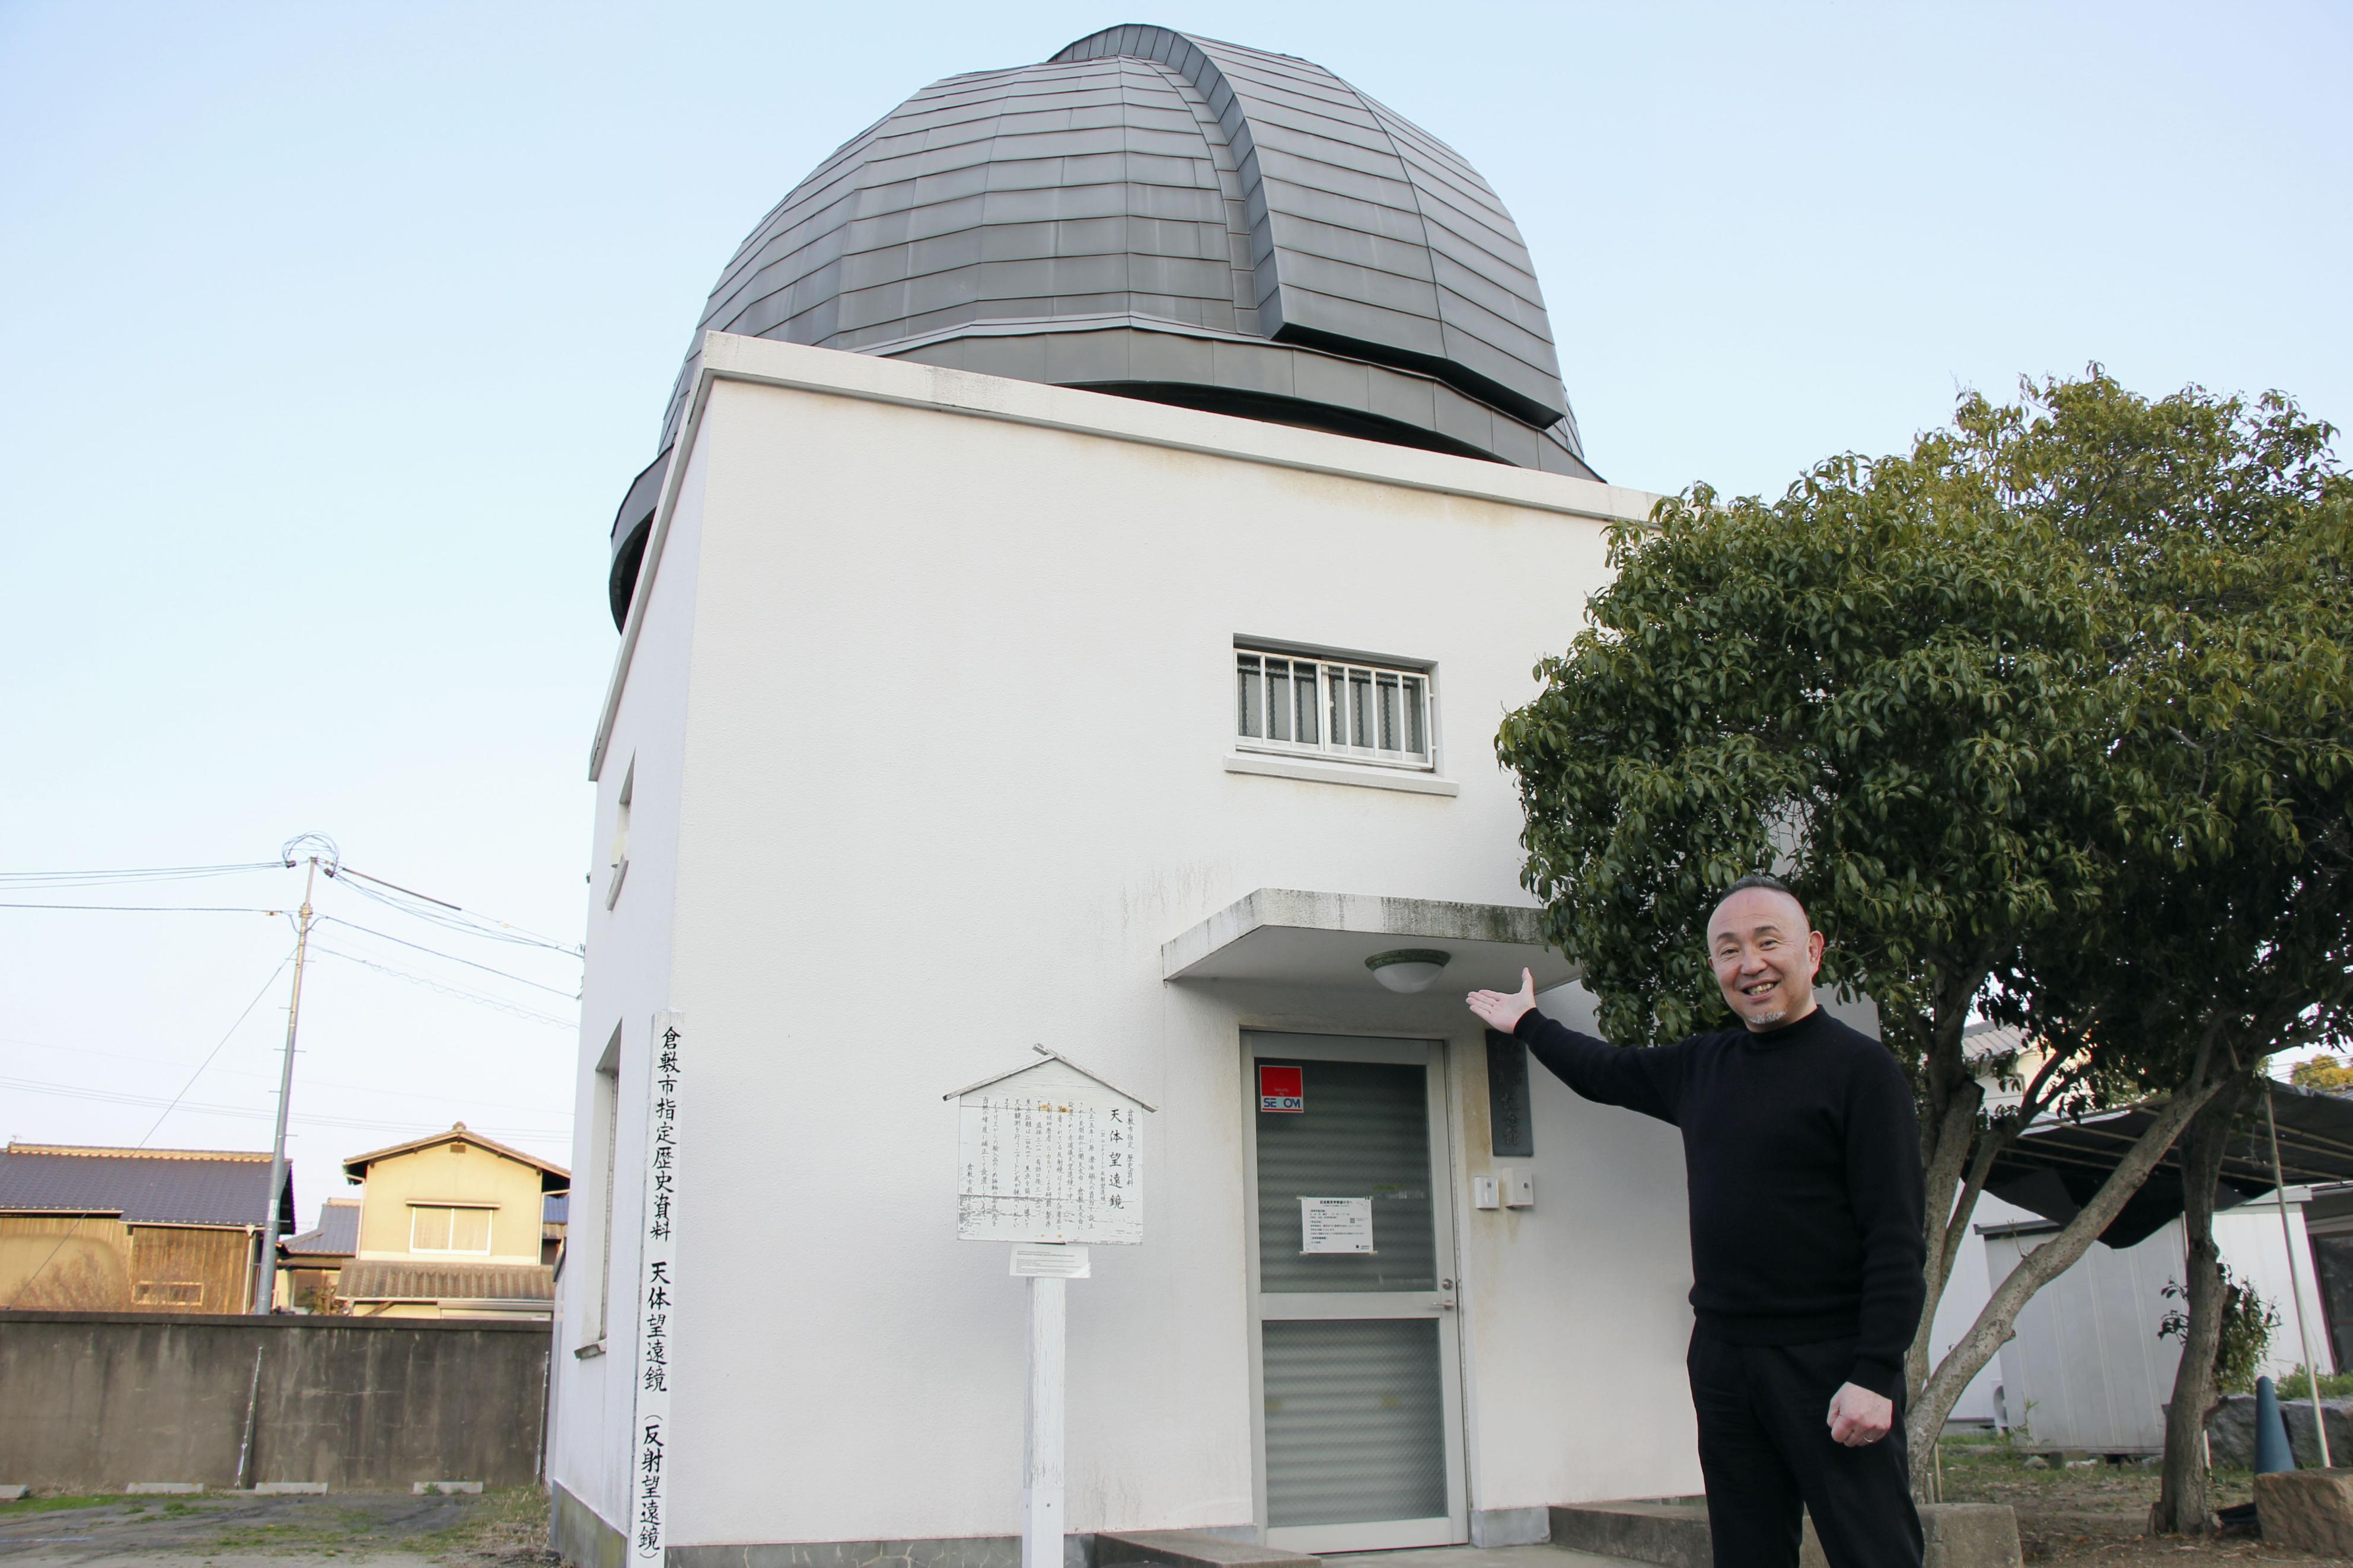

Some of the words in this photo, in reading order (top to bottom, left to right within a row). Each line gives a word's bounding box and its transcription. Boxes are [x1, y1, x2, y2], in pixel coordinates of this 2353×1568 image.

[650, 1026, 682, 1243] 倉敷市指定歴史資料
[1108, 1109, 1124, 1210] 天体望遠鏡
[1264, 1097, 1300, 1109] SECOM
[643, 1261, 672, 1393] 天体望遠鏡
